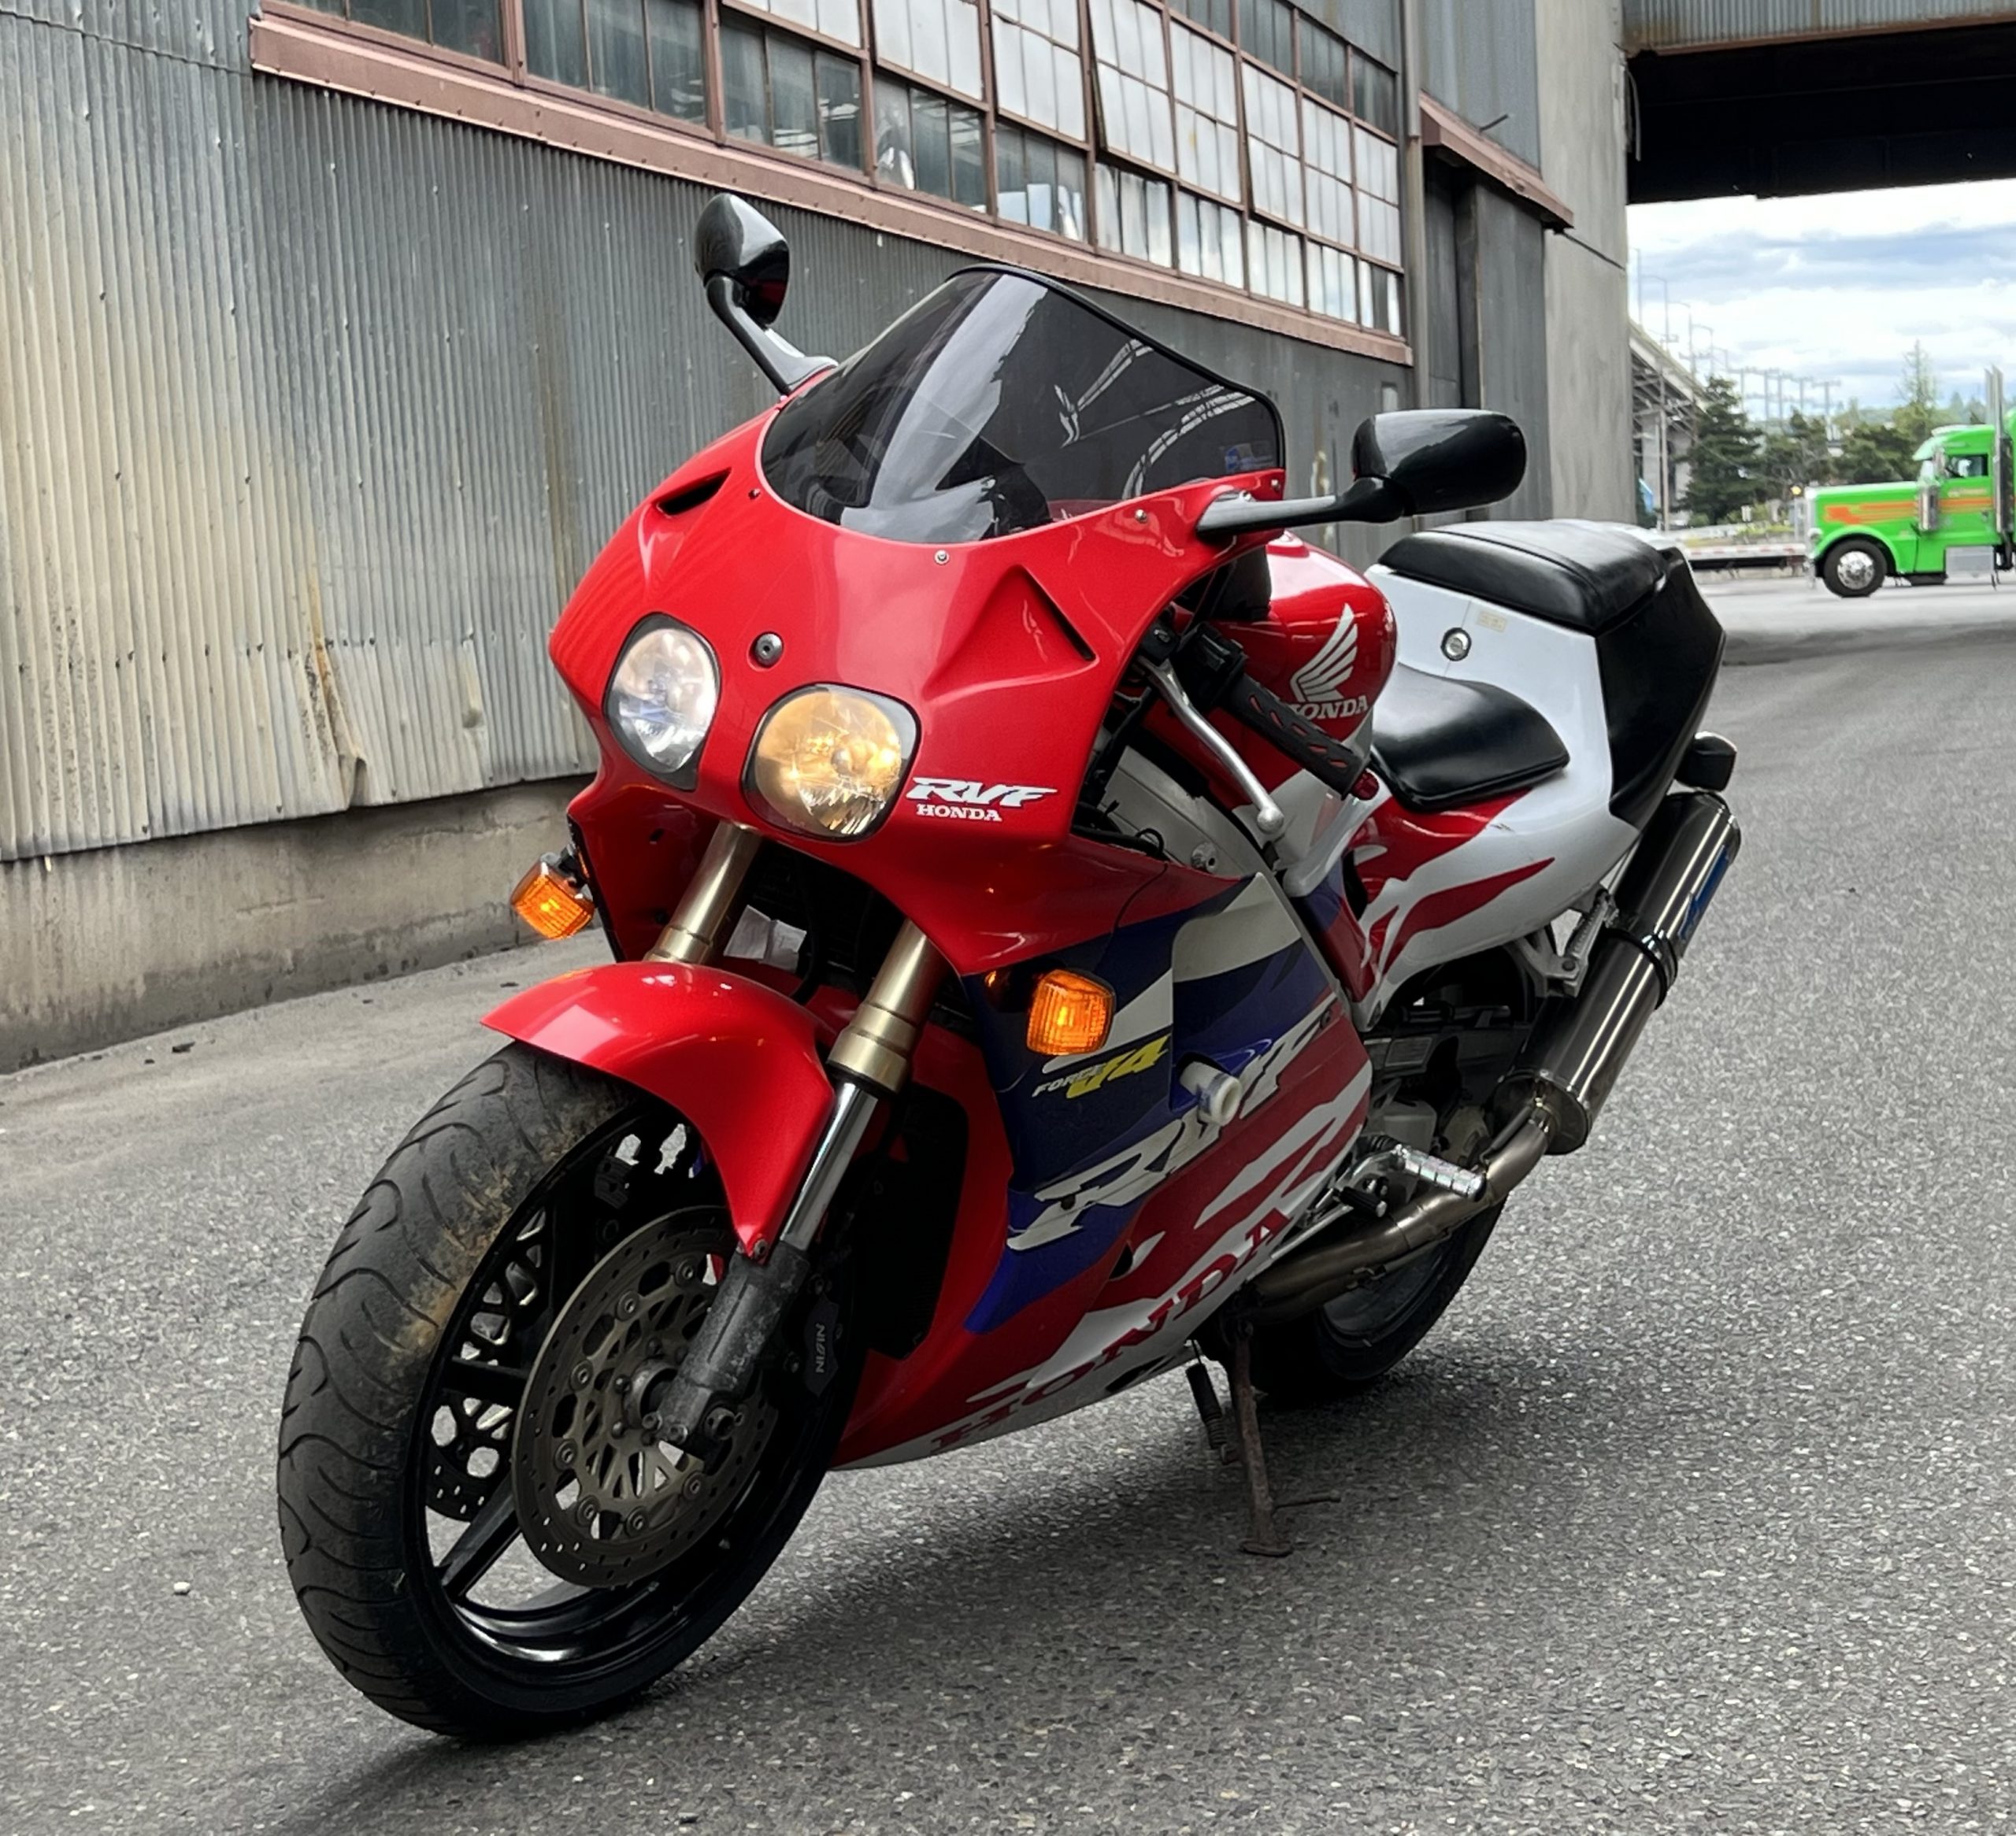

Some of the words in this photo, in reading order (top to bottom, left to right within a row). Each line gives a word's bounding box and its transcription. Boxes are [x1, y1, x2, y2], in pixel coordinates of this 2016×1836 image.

[1289, 694, 1369, 721] ONDA
[906, 776, 1058, 807] RVF
[916, 803, 1002, 822] HONDA
[930, 1209, 1292, 1454] HONDA
